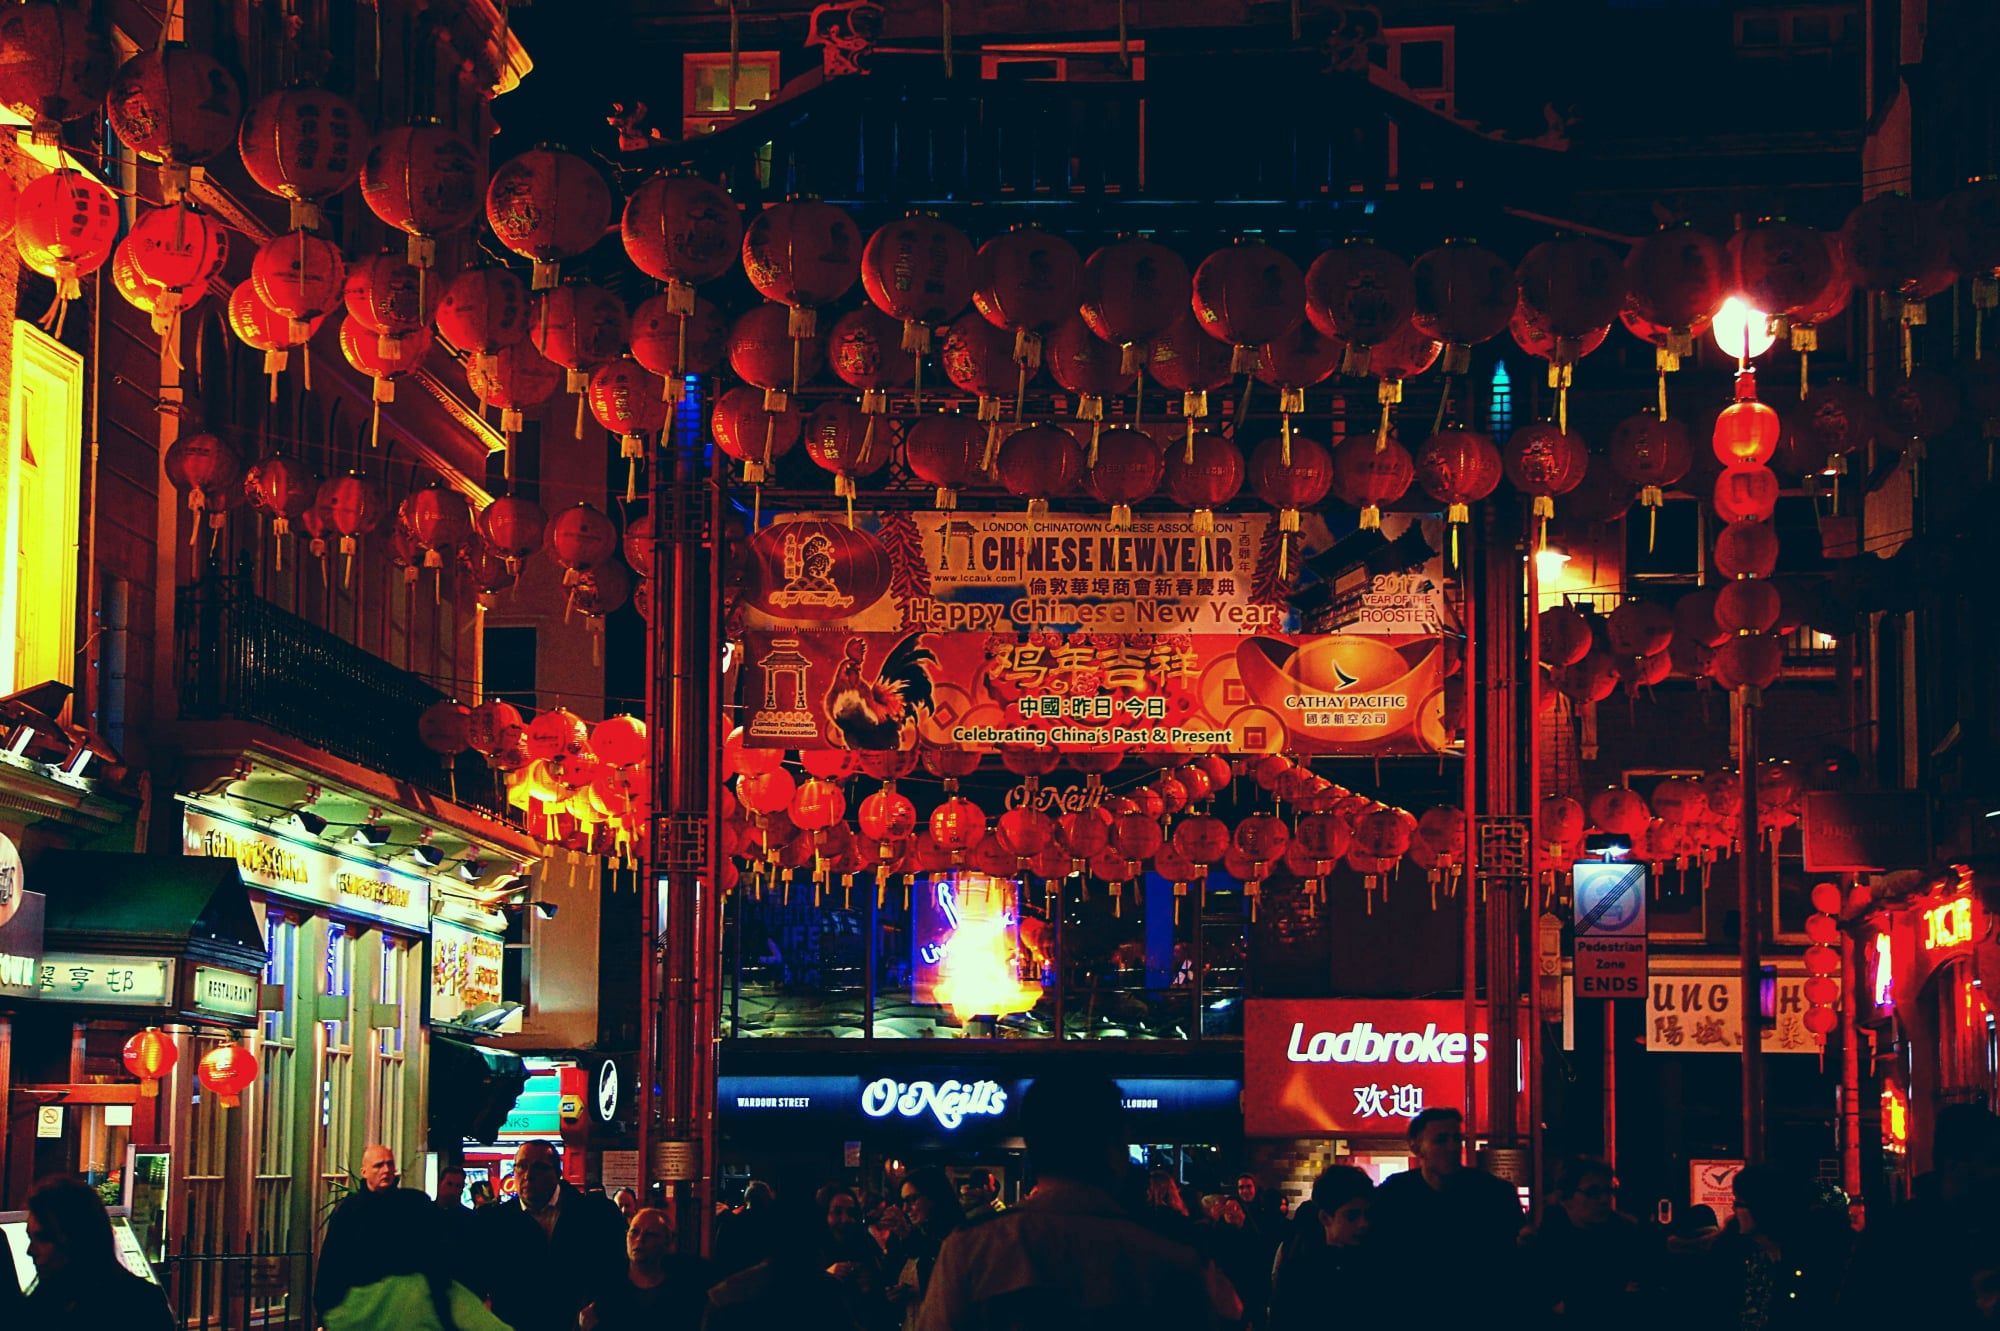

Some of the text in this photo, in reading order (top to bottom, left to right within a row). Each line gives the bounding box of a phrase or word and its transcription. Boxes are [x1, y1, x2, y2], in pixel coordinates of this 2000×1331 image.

[983, 523, 1029, 532] LONDON
[1034, 523, 1101, 532] CHINATOWN
[1157, 523, 1233, 533] ASSOCION
[983, 537, 1234, 572] CHINESE NEW YEAR
[934, 574, 1016, 583] www.lccauk.com
[1029, 578, 1236, 596] 倫敦華埠商會新春慶典
[1374, 575, 1423, 593] 2017
[1364, 595, 1431, 604] YEAR OF THE
[911, 599, 1276, 630] Happy Chinese New Year
[1360, 610, 1435, 622] ROOSTER
[988, 642, 1202, 690] 鸡年吉祥
[1286, 696, 1406, 707] CATHAY PACIFIC
[1306, 713, 1386, 724] 國泰航空公司
[953, 727, 1232, 744] Celebrating China's Past & Present
[1004, 784, 1110, 815] ONeill'
[1578, 942, 1643, 952] Pedestrian
[0, 953, 35, 985] OWN
[1596, 958, 1626, 969] Zone
[208, 980, 252, 1002] RESTAURANT
[1583, 976, 1638, 992] ENDS
[1653, 984, 1729, 1012] UNG
[1287, 1022, 1489, 1063] Ladbrokes
[737, 1097, 777, 1108] WARDOUR
[778, 1097, 810, 1108] STREET
[862, 1078, 1007, 1129] O'Neill's
[1352, 1083, 1423, 1118] 欢迎
[505, 1117, 530, 1128] NKS
